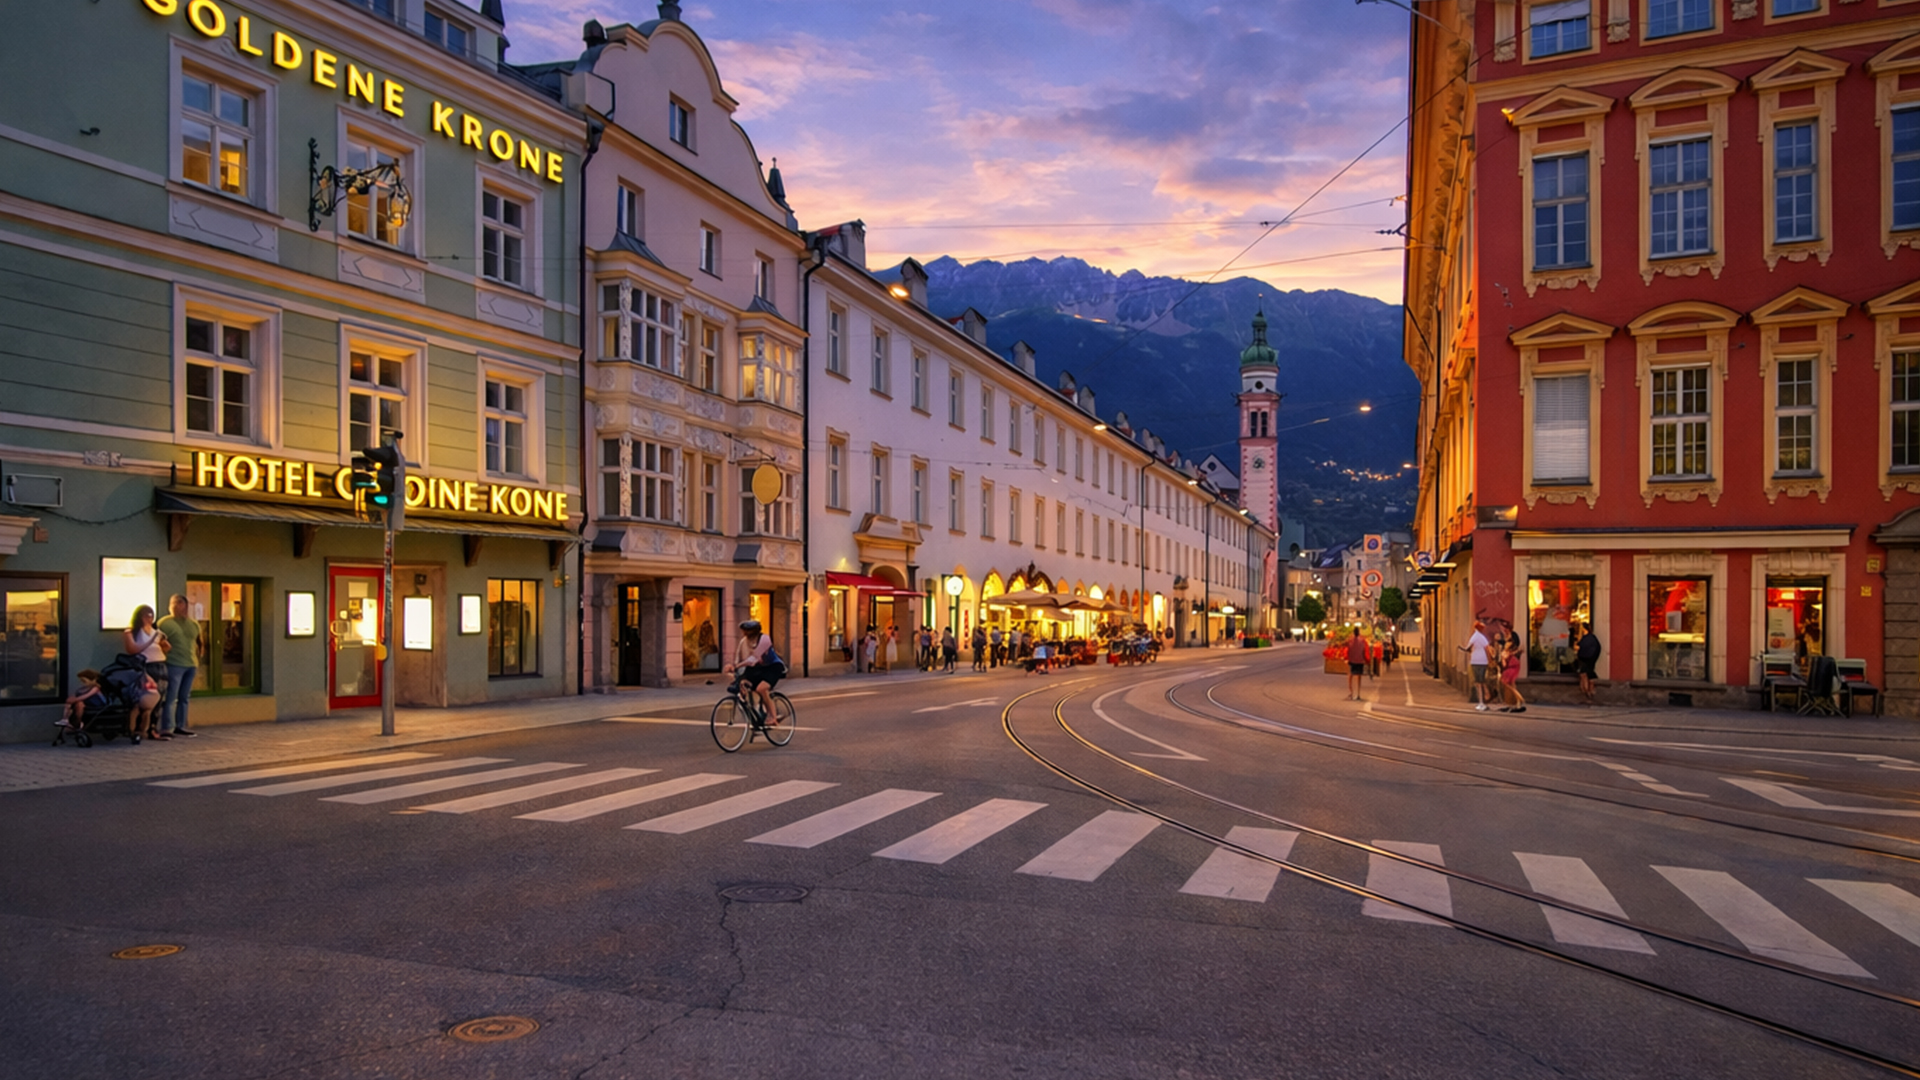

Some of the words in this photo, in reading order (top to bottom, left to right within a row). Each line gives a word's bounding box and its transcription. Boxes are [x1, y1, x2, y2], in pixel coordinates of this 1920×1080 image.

[432, 100, 564, 184] KRONE
[197, 450, 322, 499] HOTEL
[490, 484, 570, 521] KONE
